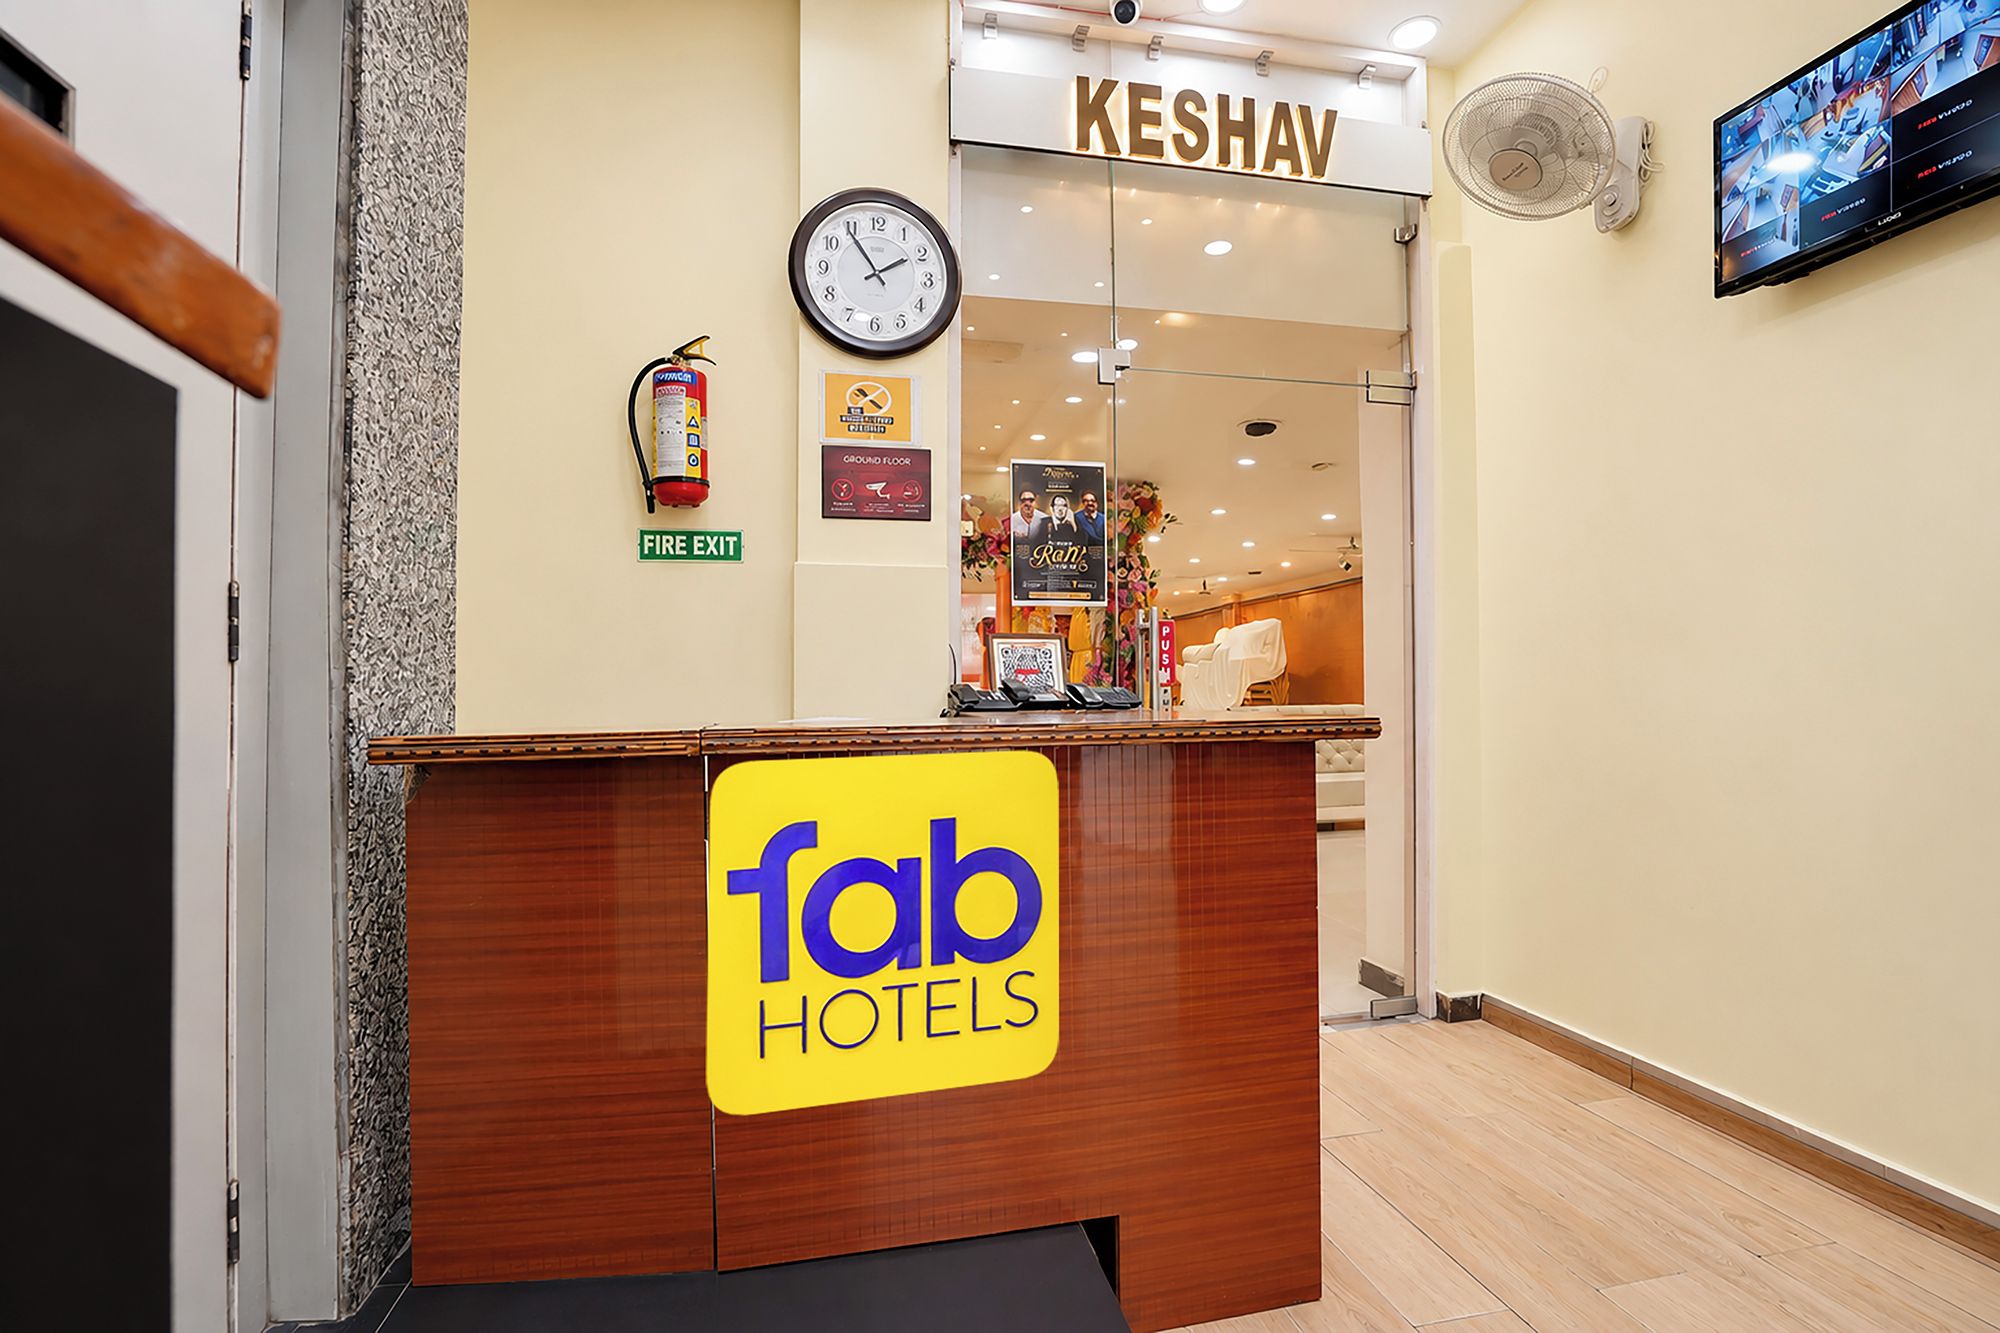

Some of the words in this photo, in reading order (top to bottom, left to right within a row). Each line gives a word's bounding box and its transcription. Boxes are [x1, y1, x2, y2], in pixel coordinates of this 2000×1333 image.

[1075, 75, 1338, 180] KESHAV
[871, 216, 886, 231] 12
[824, 235, 839, 251] 10
[917, 246, 928, 262] 2
[818, 260, 829, 275] 9
[923, 272, 934, 288] 3
[824, 285, 835, 301] 8
[914, 297, 926, 312] 4
[845, 307, 855, 322] 7
[895, 314, 906, 329] 5
[870, 317, 880, 332] 6
[843, 455, 881, 465] GROUND
[883, 456, 912, 466] FLOOR
[643, 534, 687, 555] FIRE
[693, 535, 738, 556] EXIT
[727, 817, 1043, 984] fab
[759, 970, 1039, 1059] HOTELS
